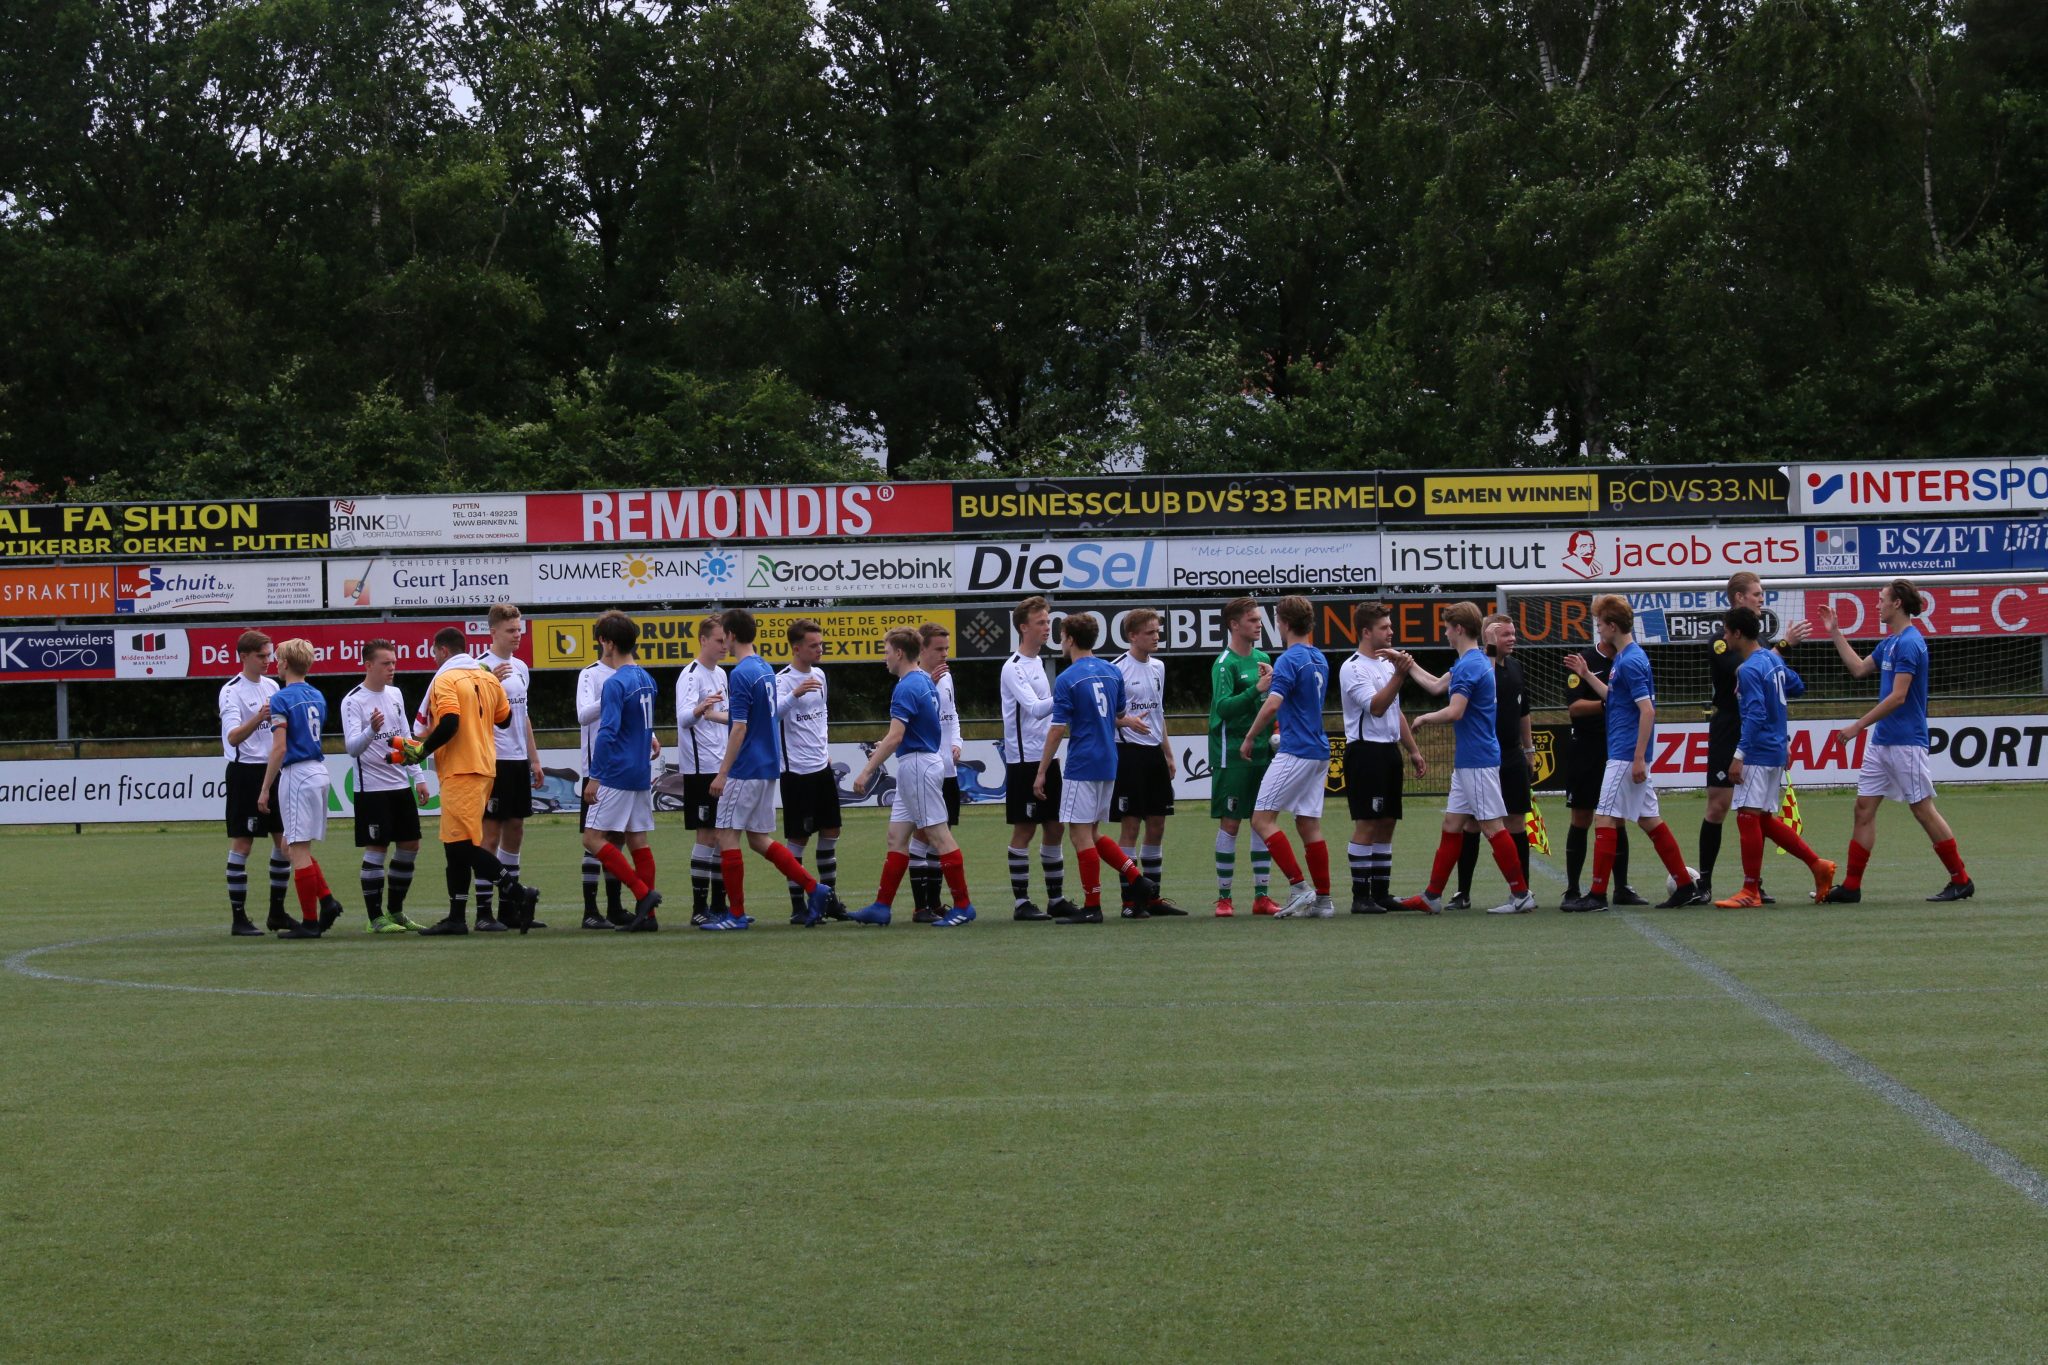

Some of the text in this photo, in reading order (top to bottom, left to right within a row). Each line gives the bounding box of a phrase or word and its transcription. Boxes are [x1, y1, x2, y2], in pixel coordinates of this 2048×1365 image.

[960, 485, 1416, 518] BUSINESSCLUB DVS'33 ERMELO
[1431, 486, 1592, 504] SAMEN WINNEN
[1609, 478, 1784, 504] BCDVS33.NL
[233, 532, 329, 551] PUTTEN
[363, 530, 442, 539] POORTAUTOMATISERING
[1877, 525, 1994, 555] ESZET
[1271, 546, 1299, 555] meer
[1391, 535, 1800, 576] instituut jacob cats
[1816, 555, 1858, 566] ESZET
[392, 558, 509, 567] SCHILDERSBEDRIJF
[538, 559, 701, 580] SUMMER RAIN
[771, 557, 953, 582] GrootJebbink
[967, 541, 1154, 591] DieSel
[1877, 556, 1957, 570] www.eszet.nl
[393, 568, 510, 592] Geurt Jansen
[1173, 564, 1377, 586] Personeelsdiensten
[4, 582, 111, 604] SPRAKTIJK
[217, 582, 235, 590] b.v.
[783, 582, 954, 592] VEHICLE SAFETY TECHNOLOGY
[394, 594, 510, 605] Ermelo (0341) 55 32 69
[1627, 591, 1671, 610] VAN
[1680, 591, 1707, 608] DE
[827, 616, 851, 626] MET
[859, 616, 875, 625] DE
[28, 633, 114, 648] tweewielers
[202, 644, 230, 665] Dé
[1092, 682, 1108, 718] 5
[307, 706, 321, 742] 6
[84, 783, 110, 801] en
[118, 774, 194, 807] fiscaal
